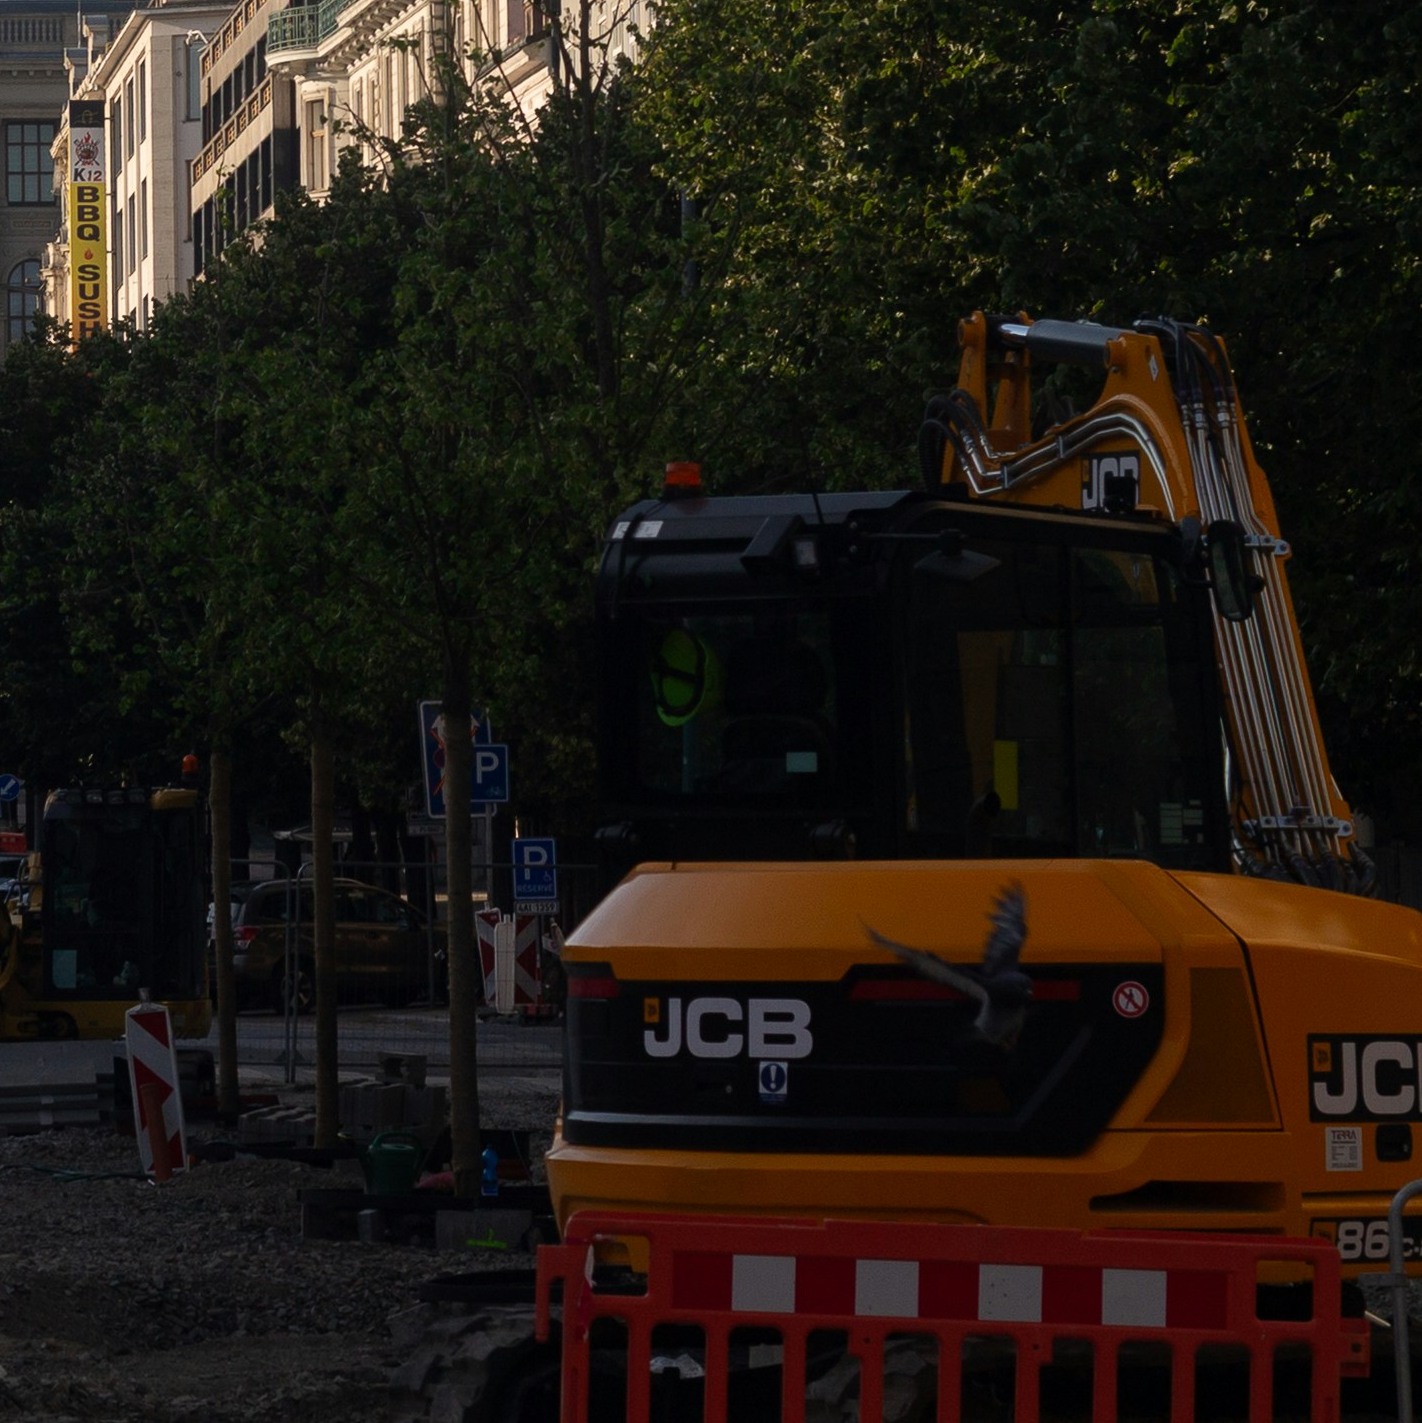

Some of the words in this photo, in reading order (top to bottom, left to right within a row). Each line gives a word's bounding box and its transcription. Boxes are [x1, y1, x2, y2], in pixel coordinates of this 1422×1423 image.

[77, 186, 100, 242] BBQ
[476, 751, 499, 784] P
[523, 845, 548, 881] P
[644, 997, 813, 1058] JCB
[1313, 1041, 1422, 1115] JC
[1331, 1130, 1357, 1140] TERRA
[1338, 1221, 1390, 1259] 86
